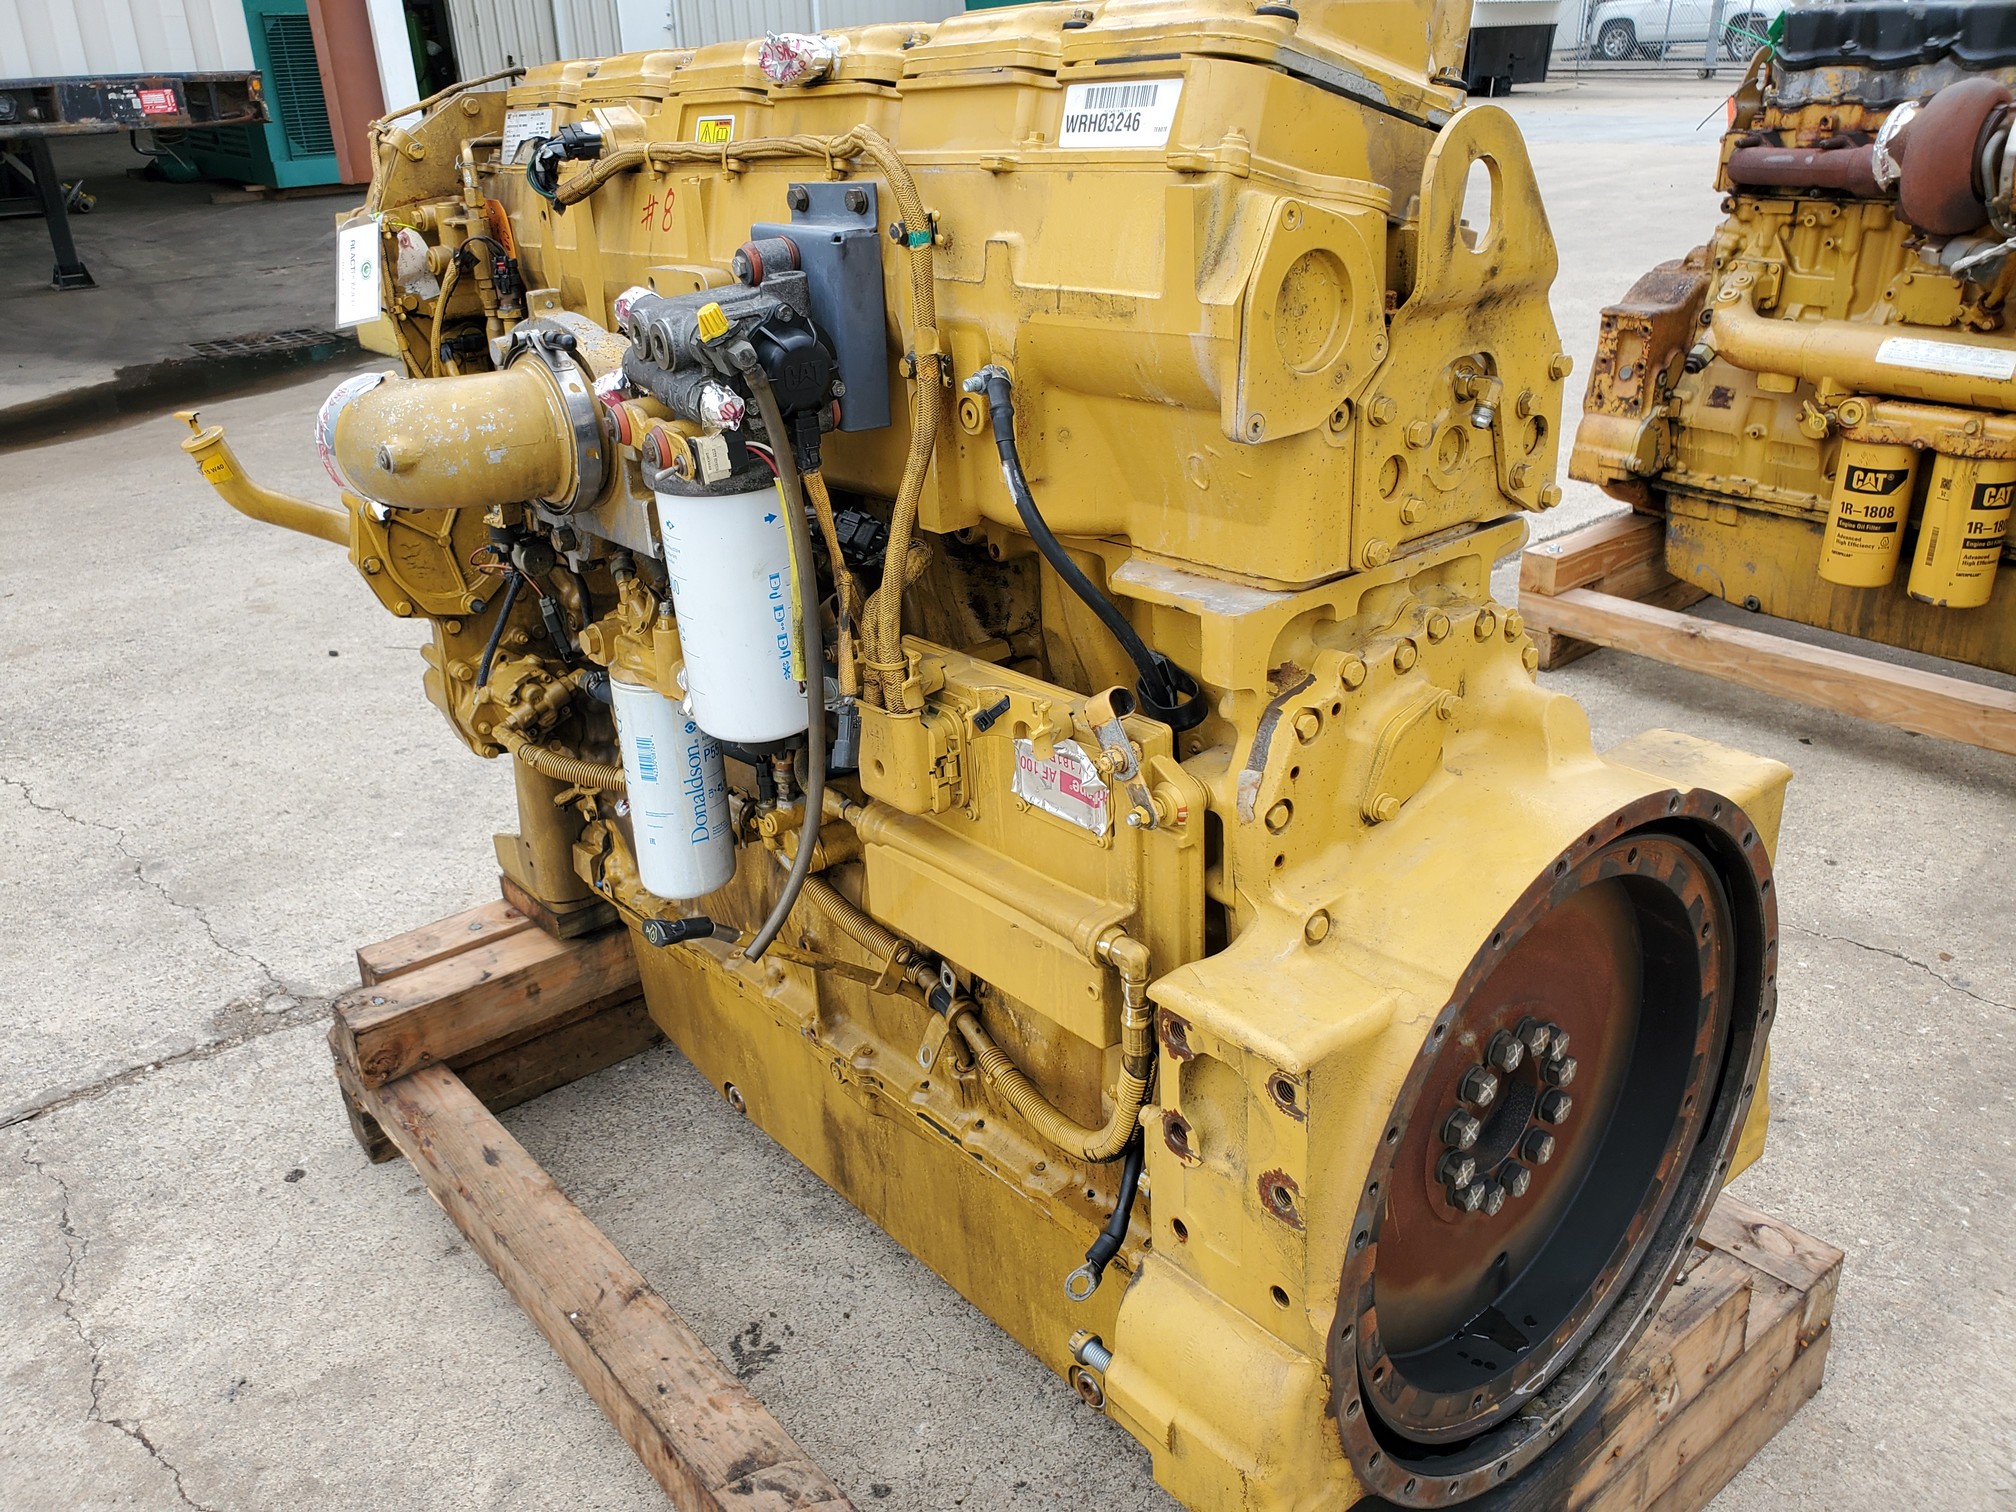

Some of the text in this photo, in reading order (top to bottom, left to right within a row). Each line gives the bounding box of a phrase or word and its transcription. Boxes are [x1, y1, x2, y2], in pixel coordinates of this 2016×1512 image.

[784, 361, 823, 391] CAT
[1852, 470, 1888, 492] CAT
[1982, 485, 2014, 507] CAT
[1840, 501, 1895, 518] 1R-1808
[1839, 520, 1856, 528] Engine
[1835, 538, 1847, 546] High
[1847, 541, 1875, 550] Efficiency
[1837, 533, 1862, 542] Advanced
[1966, 540, 1986, 548] Engine
[703, 744, 721, 762] P55
[1020, 755, 1057, 783] AF 100
[684, 743, 710, 845] Donaldson
